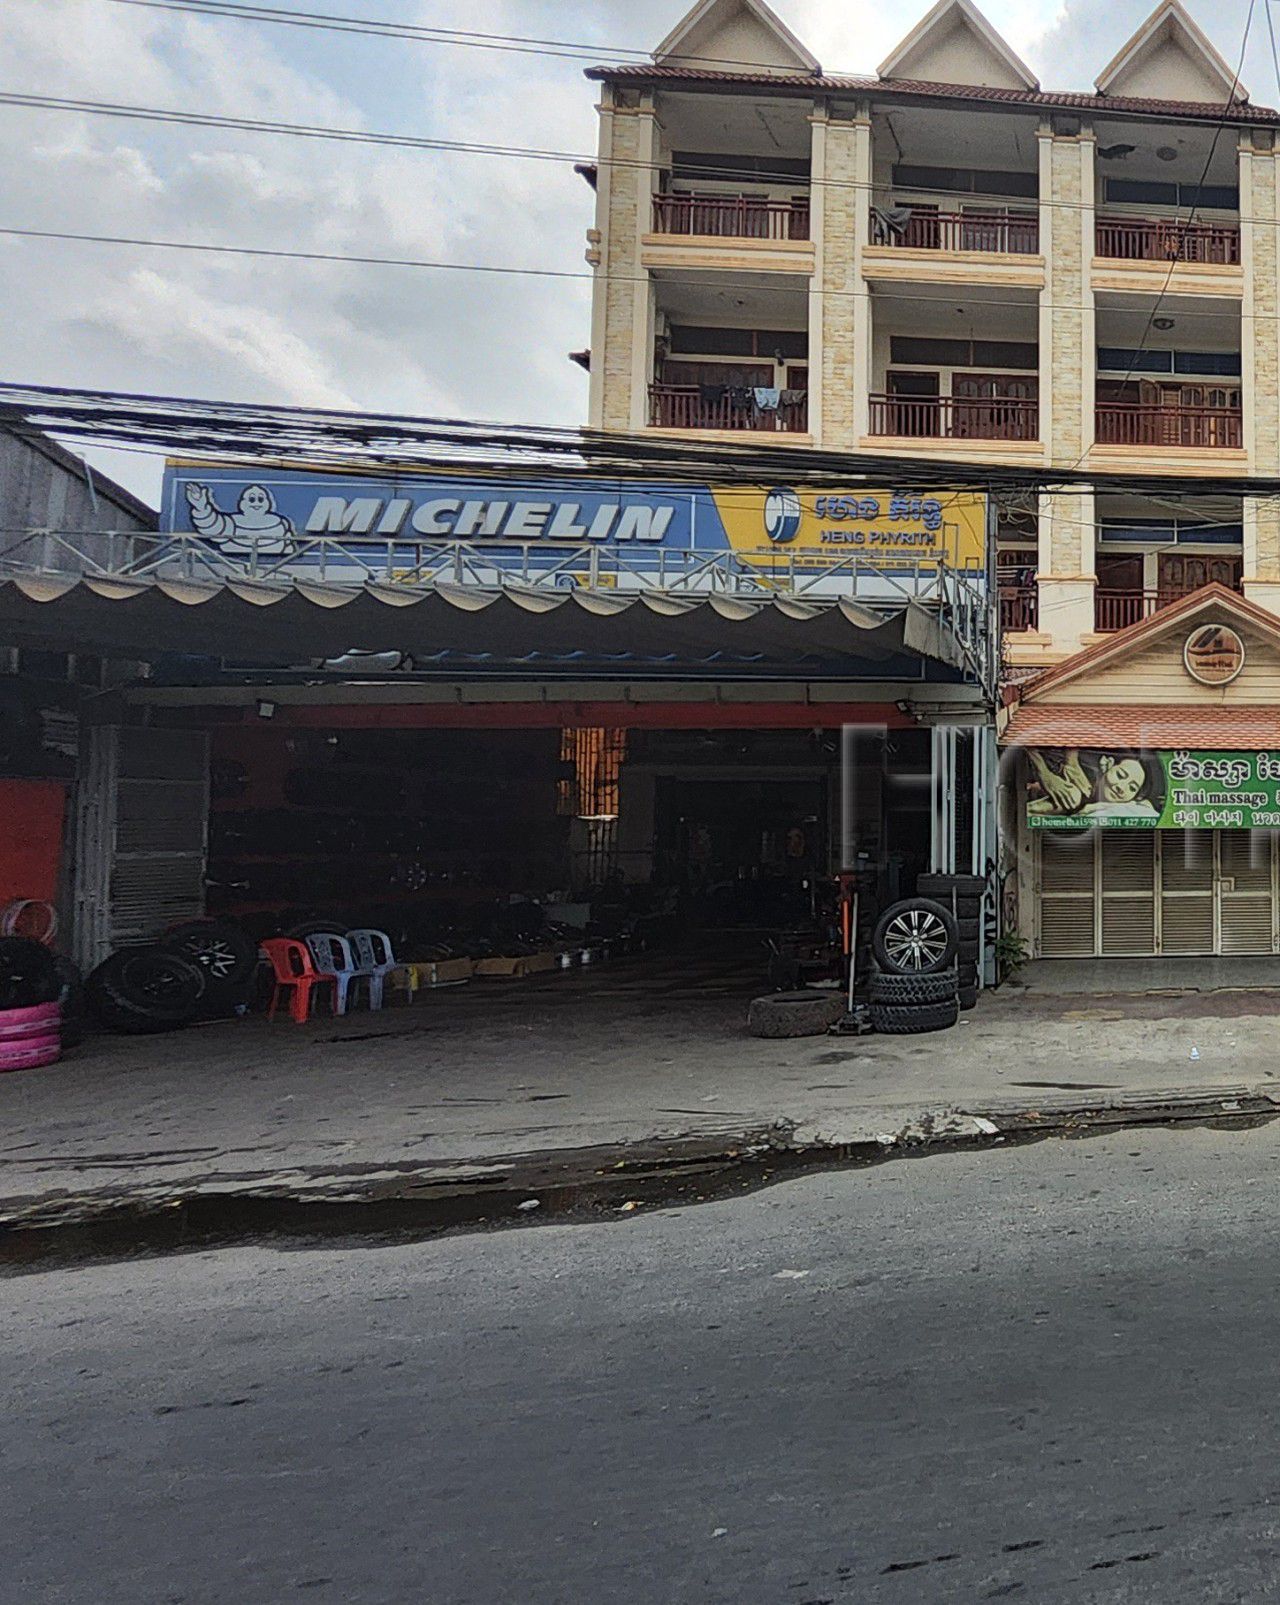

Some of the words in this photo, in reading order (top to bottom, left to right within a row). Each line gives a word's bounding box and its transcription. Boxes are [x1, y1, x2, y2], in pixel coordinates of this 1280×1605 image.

[305, 497, 675, 541] MICHELIN
[820, 531, 865, 545] HENG
[868, 531, 937, 546] PHYRITH
[1173, 789, 1206, 805] Thai
[1207, 792, 1268, 808] massage
